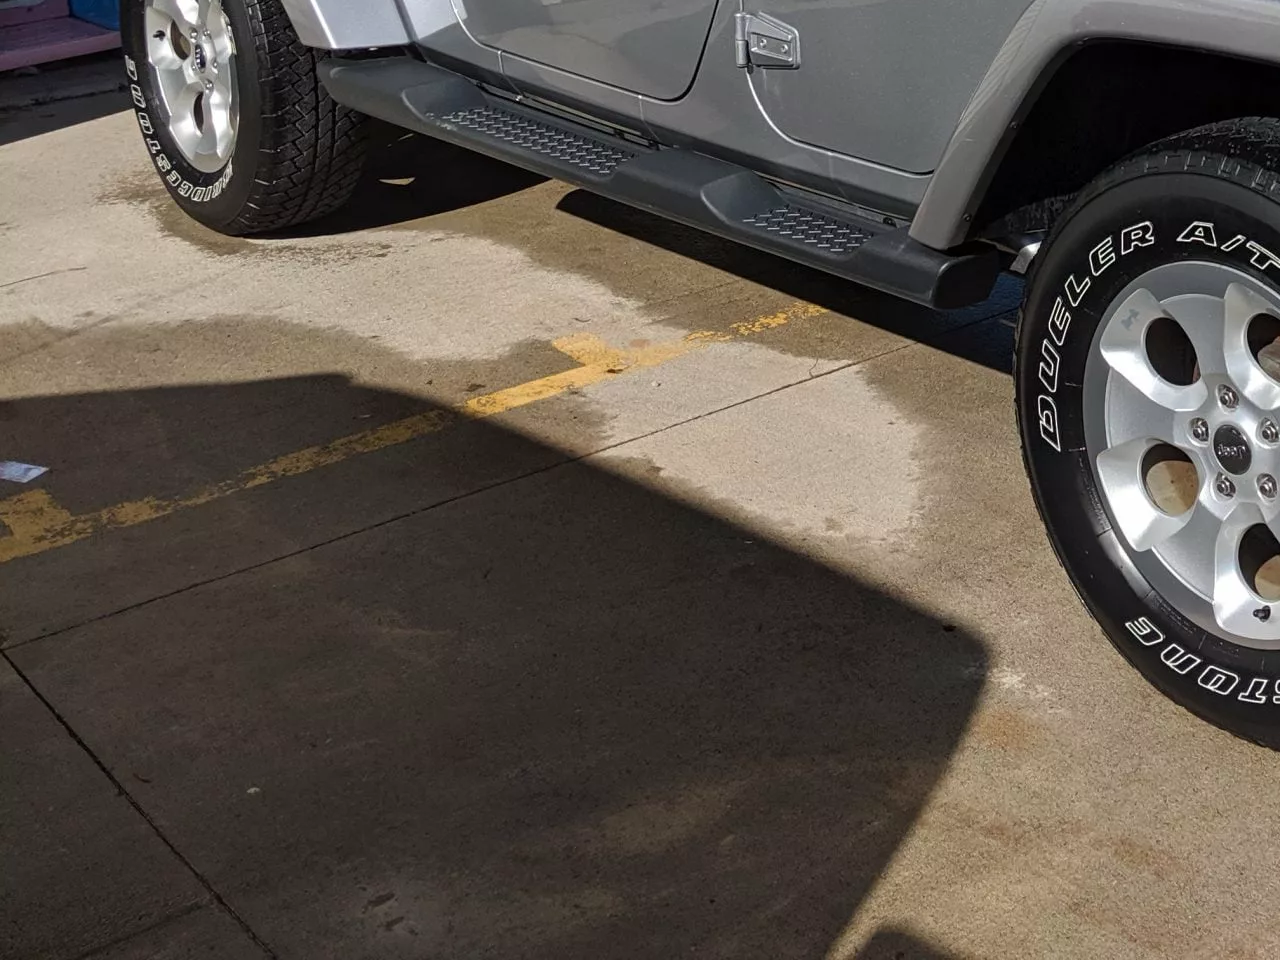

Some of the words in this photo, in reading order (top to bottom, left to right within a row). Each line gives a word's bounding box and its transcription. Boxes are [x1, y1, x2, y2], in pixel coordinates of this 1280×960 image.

[124, 54, 235, 202] BRIDGESTONE
[1037, 220, 1156, 452] DUELER
[1217, 443, 1246, 460] Jeep
